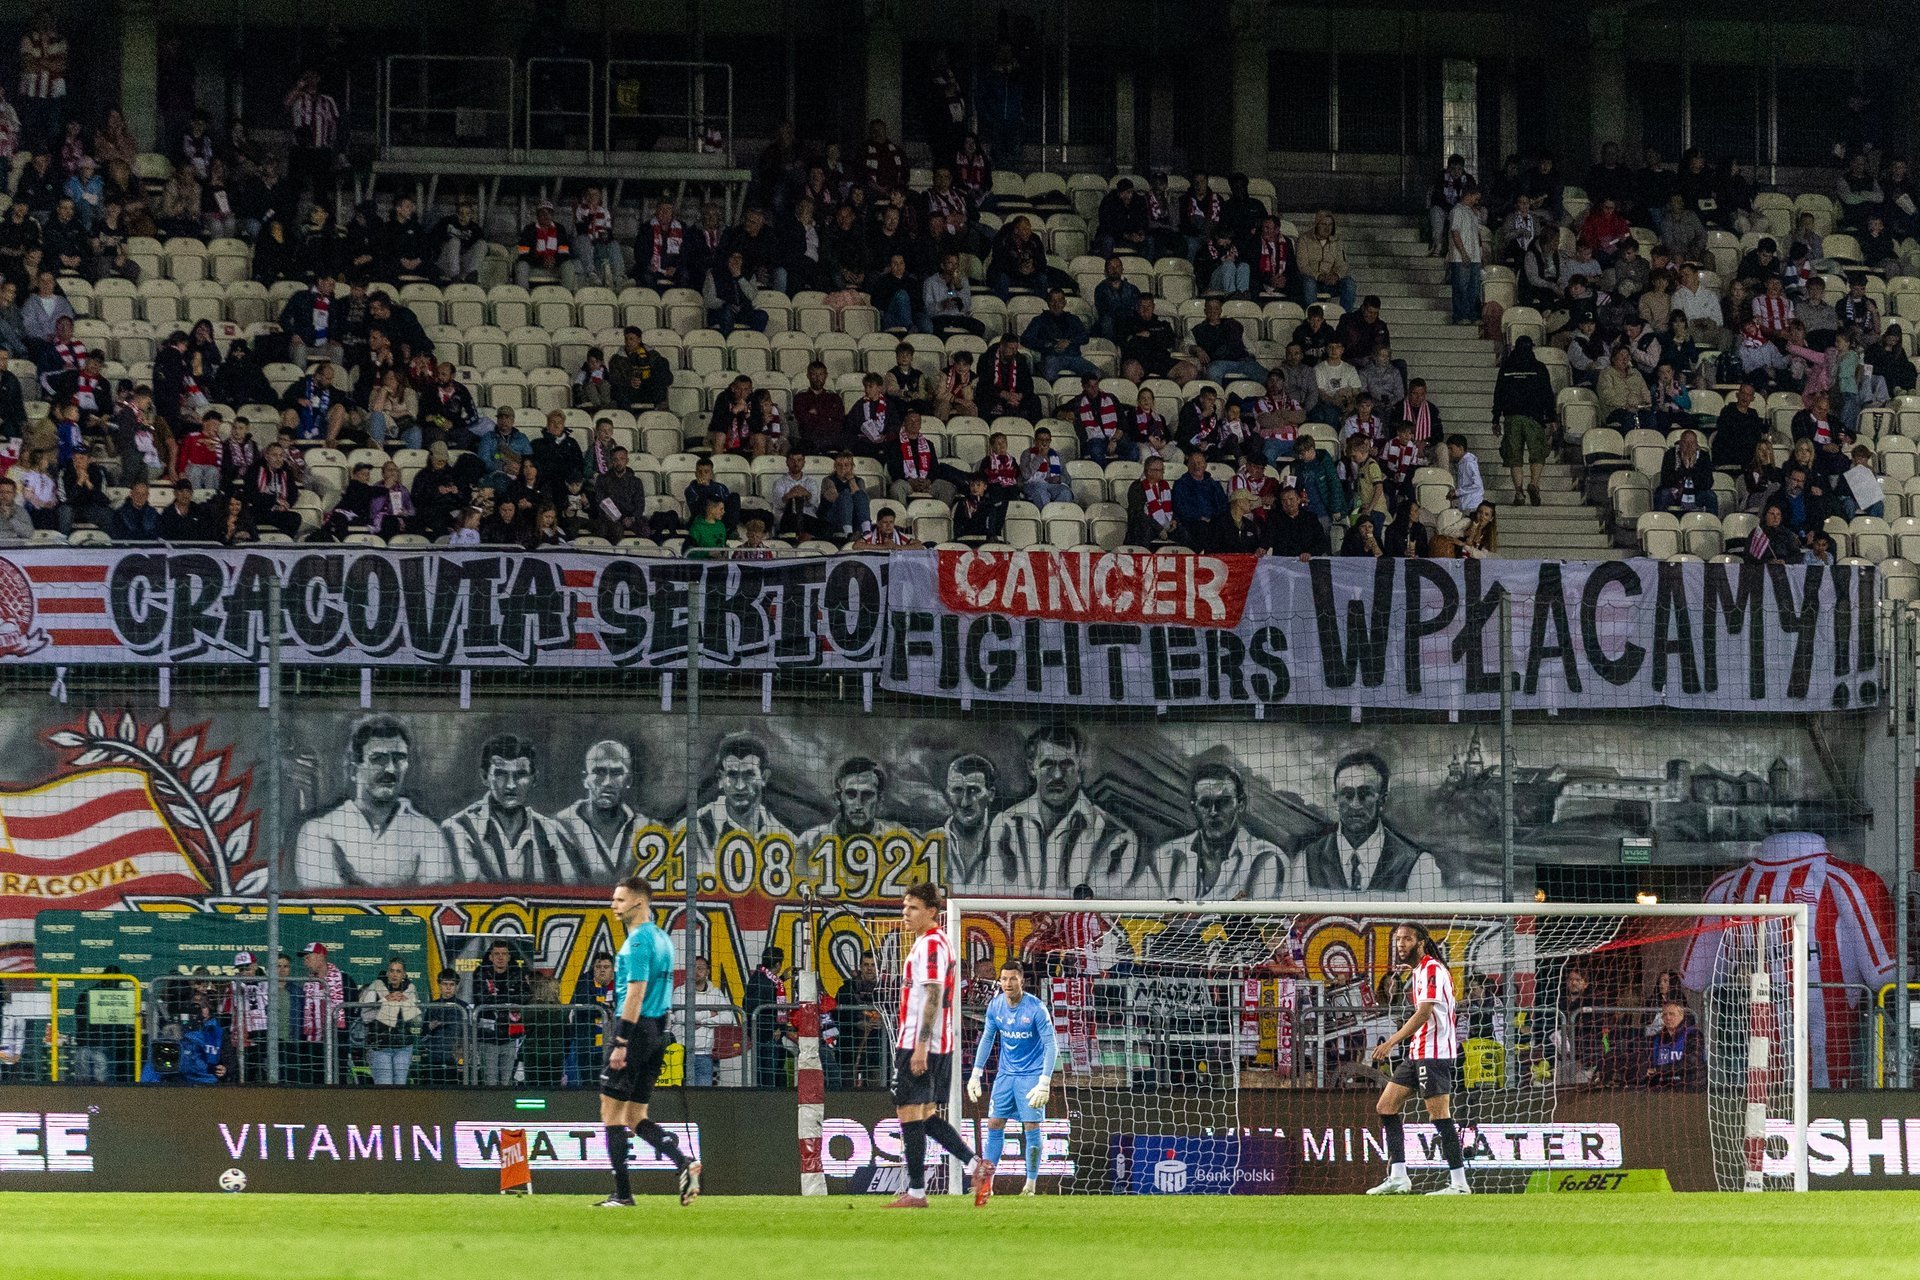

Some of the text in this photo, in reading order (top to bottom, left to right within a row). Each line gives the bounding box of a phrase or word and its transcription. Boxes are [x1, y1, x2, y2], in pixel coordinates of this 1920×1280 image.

[111, 552, 889, 667] CRACOVIA SEKTO
[953, 550, 1229, 621] CANCER
[890, 611, 1291, 703] FIGHTERS
[1309, 557, 1878, 709] WPŁACAMY!!
[636, 830, 948, 899] 21.08.1921
[999, 1029, 1033, 1039] OMARCH
[218, 1123, 443, 1161] VITAMIN
[1196, 1168, 1275, 1182] Bank Polski
[1558, 1172, 1628, 1192] forBET
